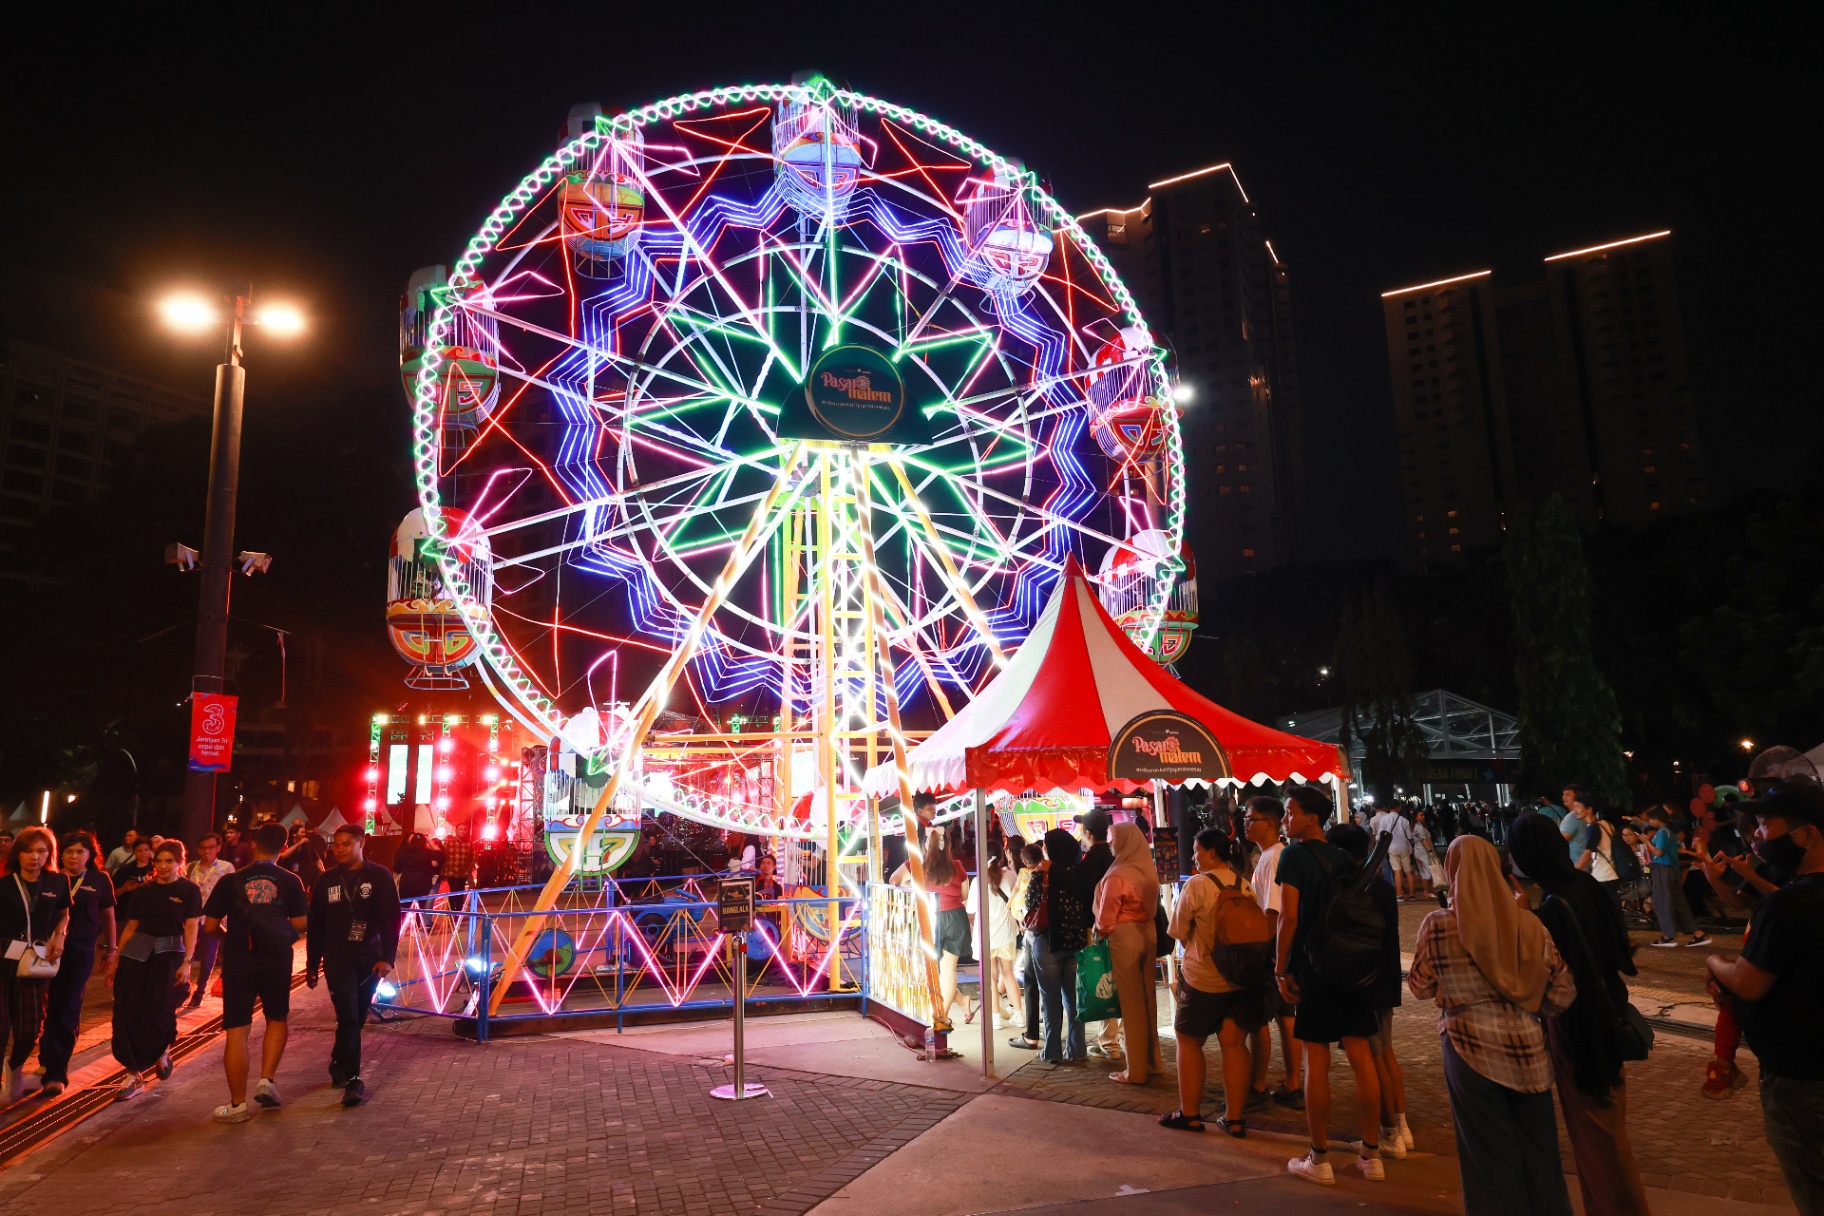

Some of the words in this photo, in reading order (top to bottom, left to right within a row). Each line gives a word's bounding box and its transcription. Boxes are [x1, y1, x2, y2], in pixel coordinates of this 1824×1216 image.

[820, 371, 857, 392] Pasar
[848, 386, 892, 403] malem
[1132, 736, 1167, 756] Pasar
[1159, 747, 1203, 764] malem
